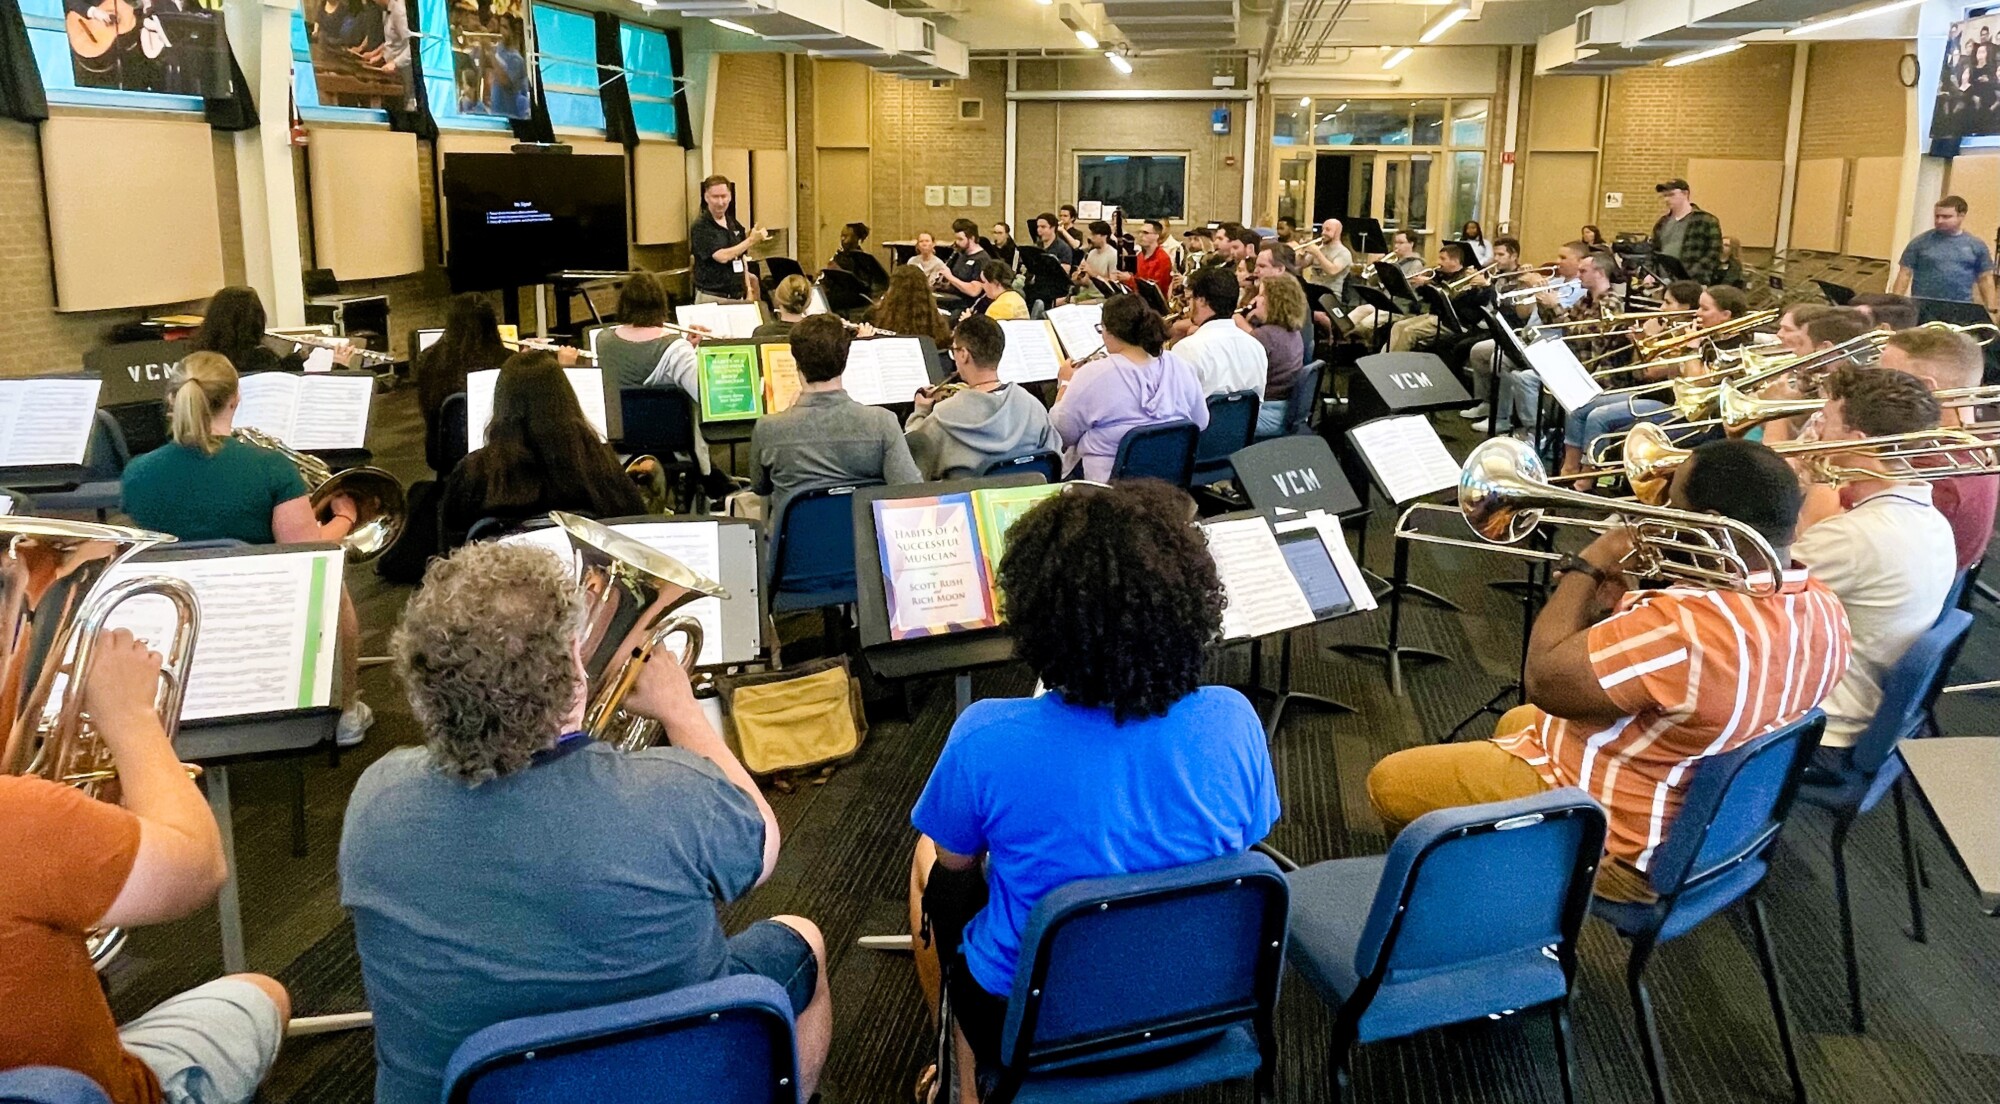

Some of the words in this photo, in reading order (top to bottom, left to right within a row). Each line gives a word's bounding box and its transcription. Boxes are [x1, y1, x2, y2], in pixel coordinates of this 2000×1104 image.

[1389, 371, 1434, 390] VCM
[1271, 467, 1322, 497] VCM
[894, 528, 933, 539] HABITS
[935, 527, 947, 536] OF
[952, 525, 959, 534] A
[897, 538, 960, 551] SUCCESSFUL
[904, 551, 957, 563] MUSICIAN
[909, 581, 937, 591] SCOTT
[939, 579, 963, 588] RUSH
[911, 596, 934, 606] RICH
[937, 592, 966, 602] MOON
